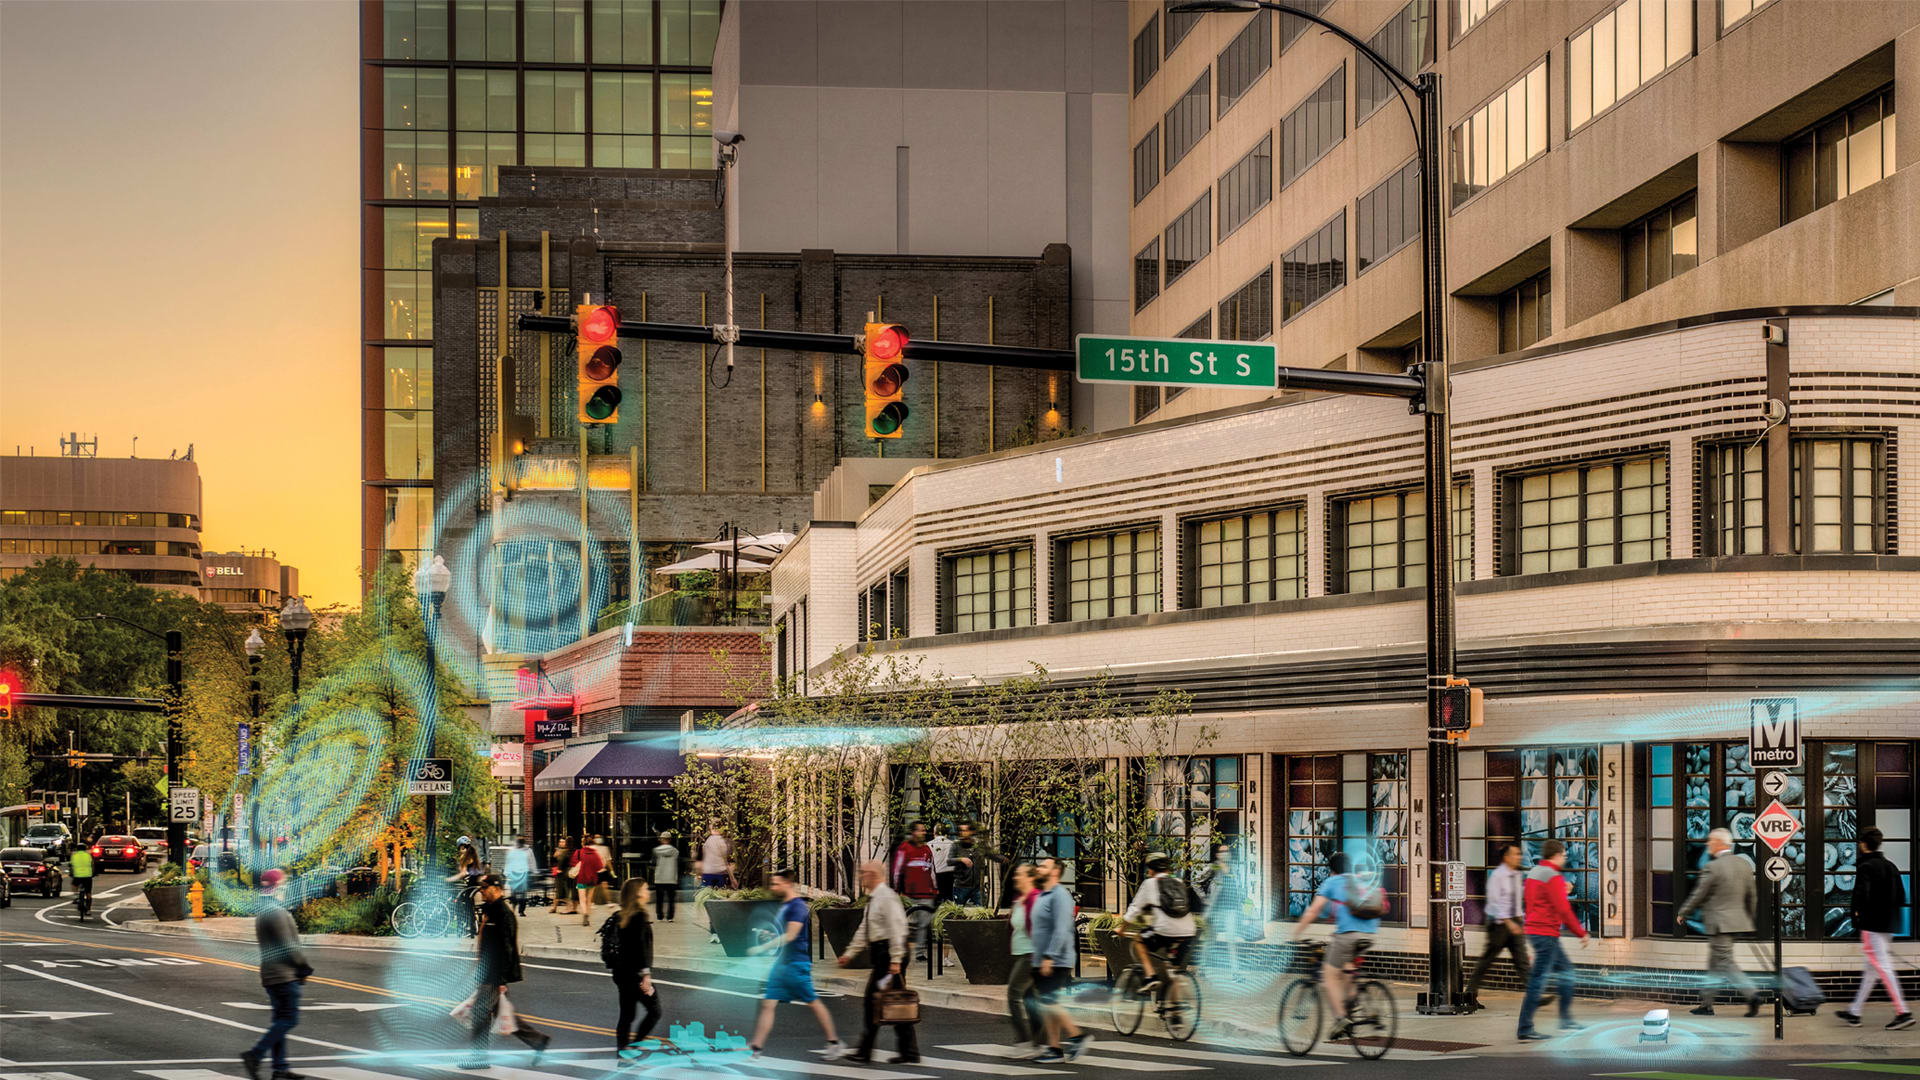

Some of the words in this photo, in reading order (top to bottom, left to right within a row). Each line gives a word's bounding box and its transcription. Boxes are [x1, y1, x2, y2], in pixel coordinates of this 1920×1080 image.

[1105, 348, 1169, 374] 15th
[1189, 351, 1218, 376] St
[1236, 353, 1251, 377] S
[215, 566, 244, 576] BELL
[1753, 703, 1795, 749] M
[503, 752, 521, 760] CVS
[1753, 749, 1795, 761] metro
[410, 783, 429, 791] BIKE
[430, 783, 451, 791] LANE
[174, 806, 196, 819] 25
[1761, 820, 1792, 833] VRE
[1249, 780, 1257, 895] BAKERY
[1414, 799, 1423, 878] MEAT
[1607, 761, 1618, 919] SEAFOOD
